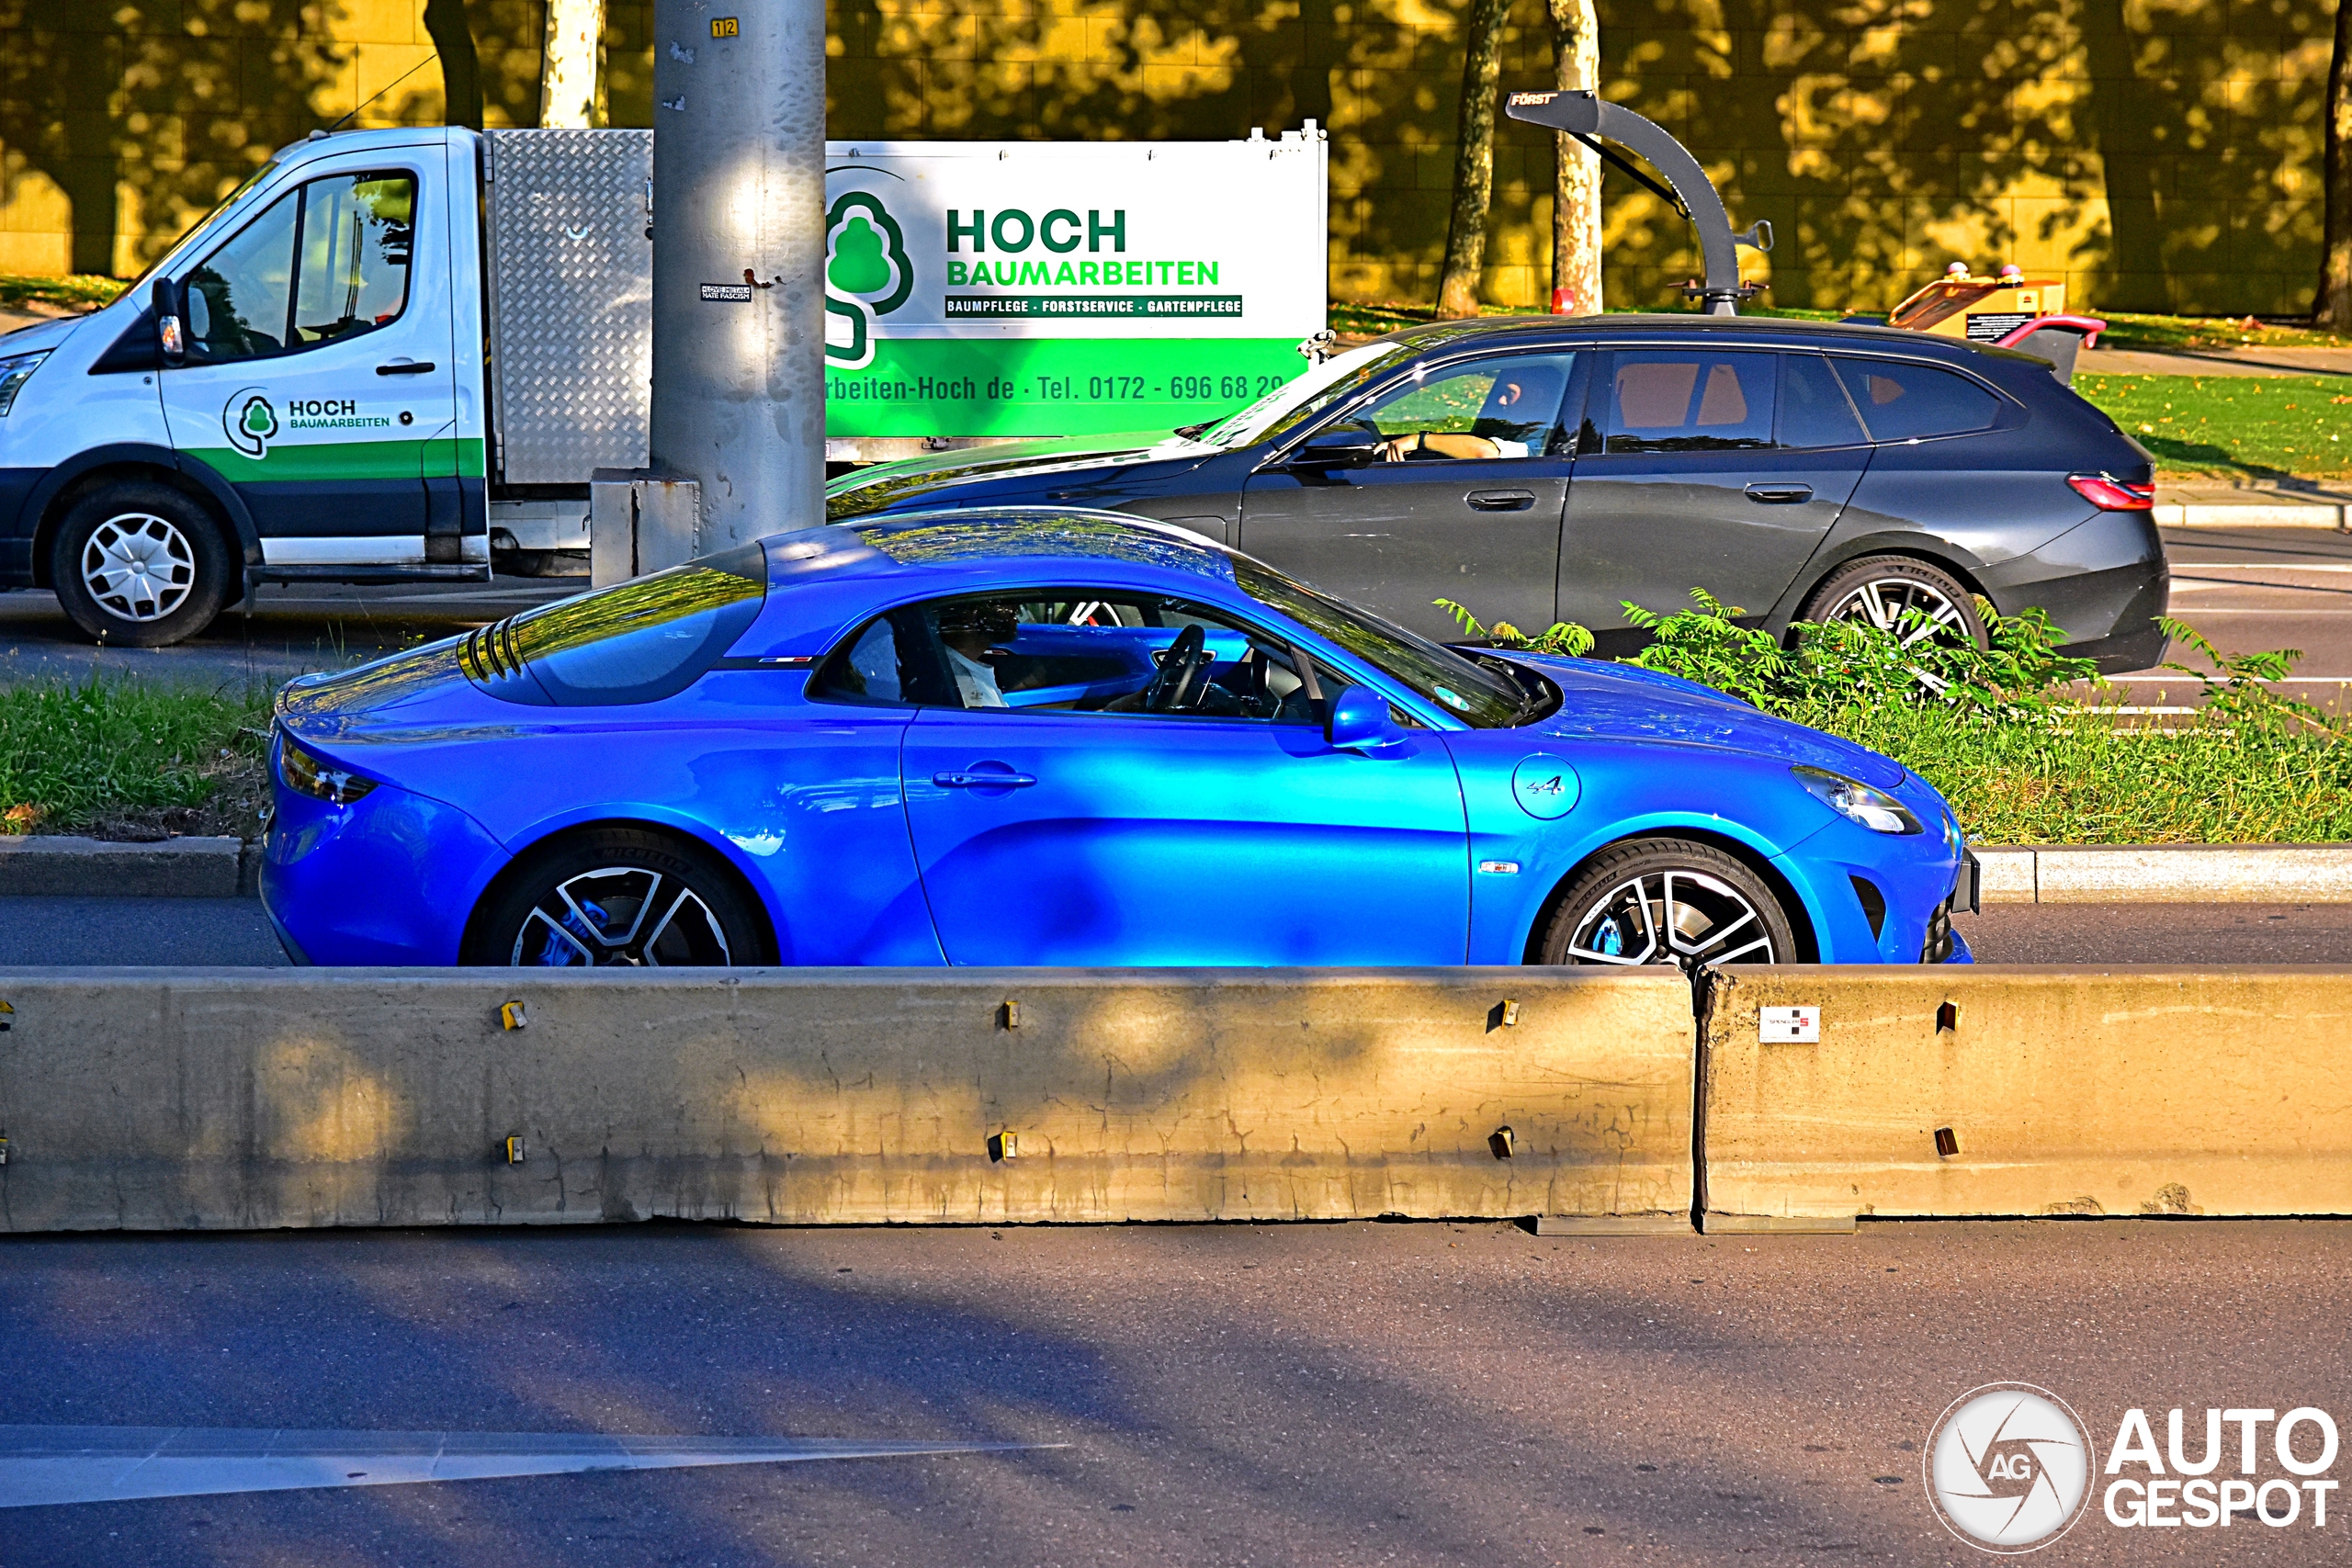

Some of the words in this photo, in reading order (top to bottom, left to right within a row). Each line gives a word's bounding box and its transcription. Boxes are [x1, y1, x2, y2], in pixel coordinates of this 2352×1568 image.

[1511, 93, 1558, 106] FÖRST
[946, 209, 1125, 253] HOCH
[946, 261, 1218, 286] BAUMARBEITEN
[947, 299, 1028, 312] BAUMPFLEGE
[1042, 299, 1134, 312] FORSTSERVICE
[1147, 299, 1241, 312] GARTENPFLEGE
[988, 377, 1014, 400] de
[1037, 377, 1079, 400] Tel.
[1090, 376, 1145, 399] 0172
[1170, 376, 1212, 399] 696
[1221, 376, 1248, 399] 68
[289, 400, 356, 416] HOCH
[290, 417, 390, 428] BAUMARBEITEN
[602, 847, 687, 871] MICHELIN
[1577, 873, 1615, 909] MICHELIN
